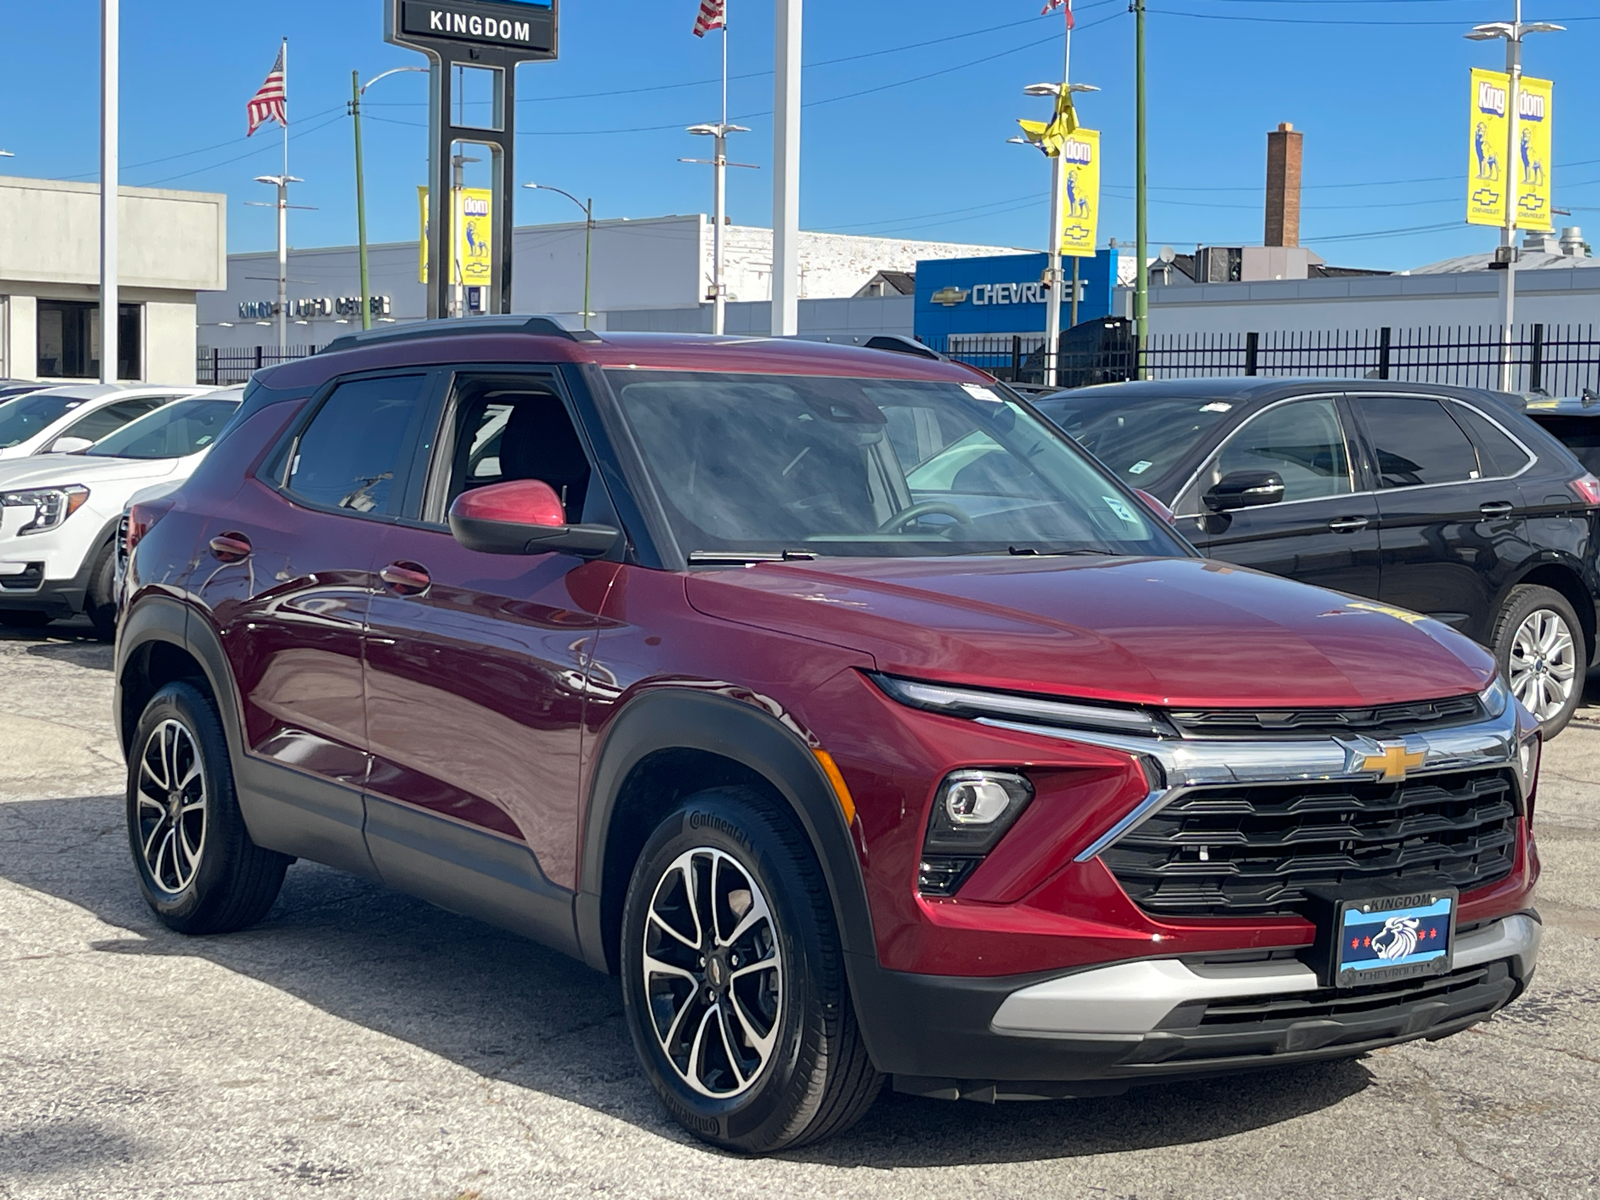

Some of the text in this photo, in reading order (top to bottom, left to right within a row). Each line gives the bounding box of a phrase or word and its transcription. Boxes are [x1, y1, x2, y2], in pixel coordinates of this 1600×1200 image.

[430, 10, 530, 41] KINGDOM
[1478, 81, 1545, 122] King dom
[1066, 137, 1092, 165] dom
[464, 196, 489, 217] dom
[336, 294, 390, 315] CENER
[972, 280, 1088, 305] CHEVROET
[690, 810, 750, 848] Continental
[1370, 893, 1432, 911] KINGDOM
[1363, 965, 1425, 981] CHEVROLET
